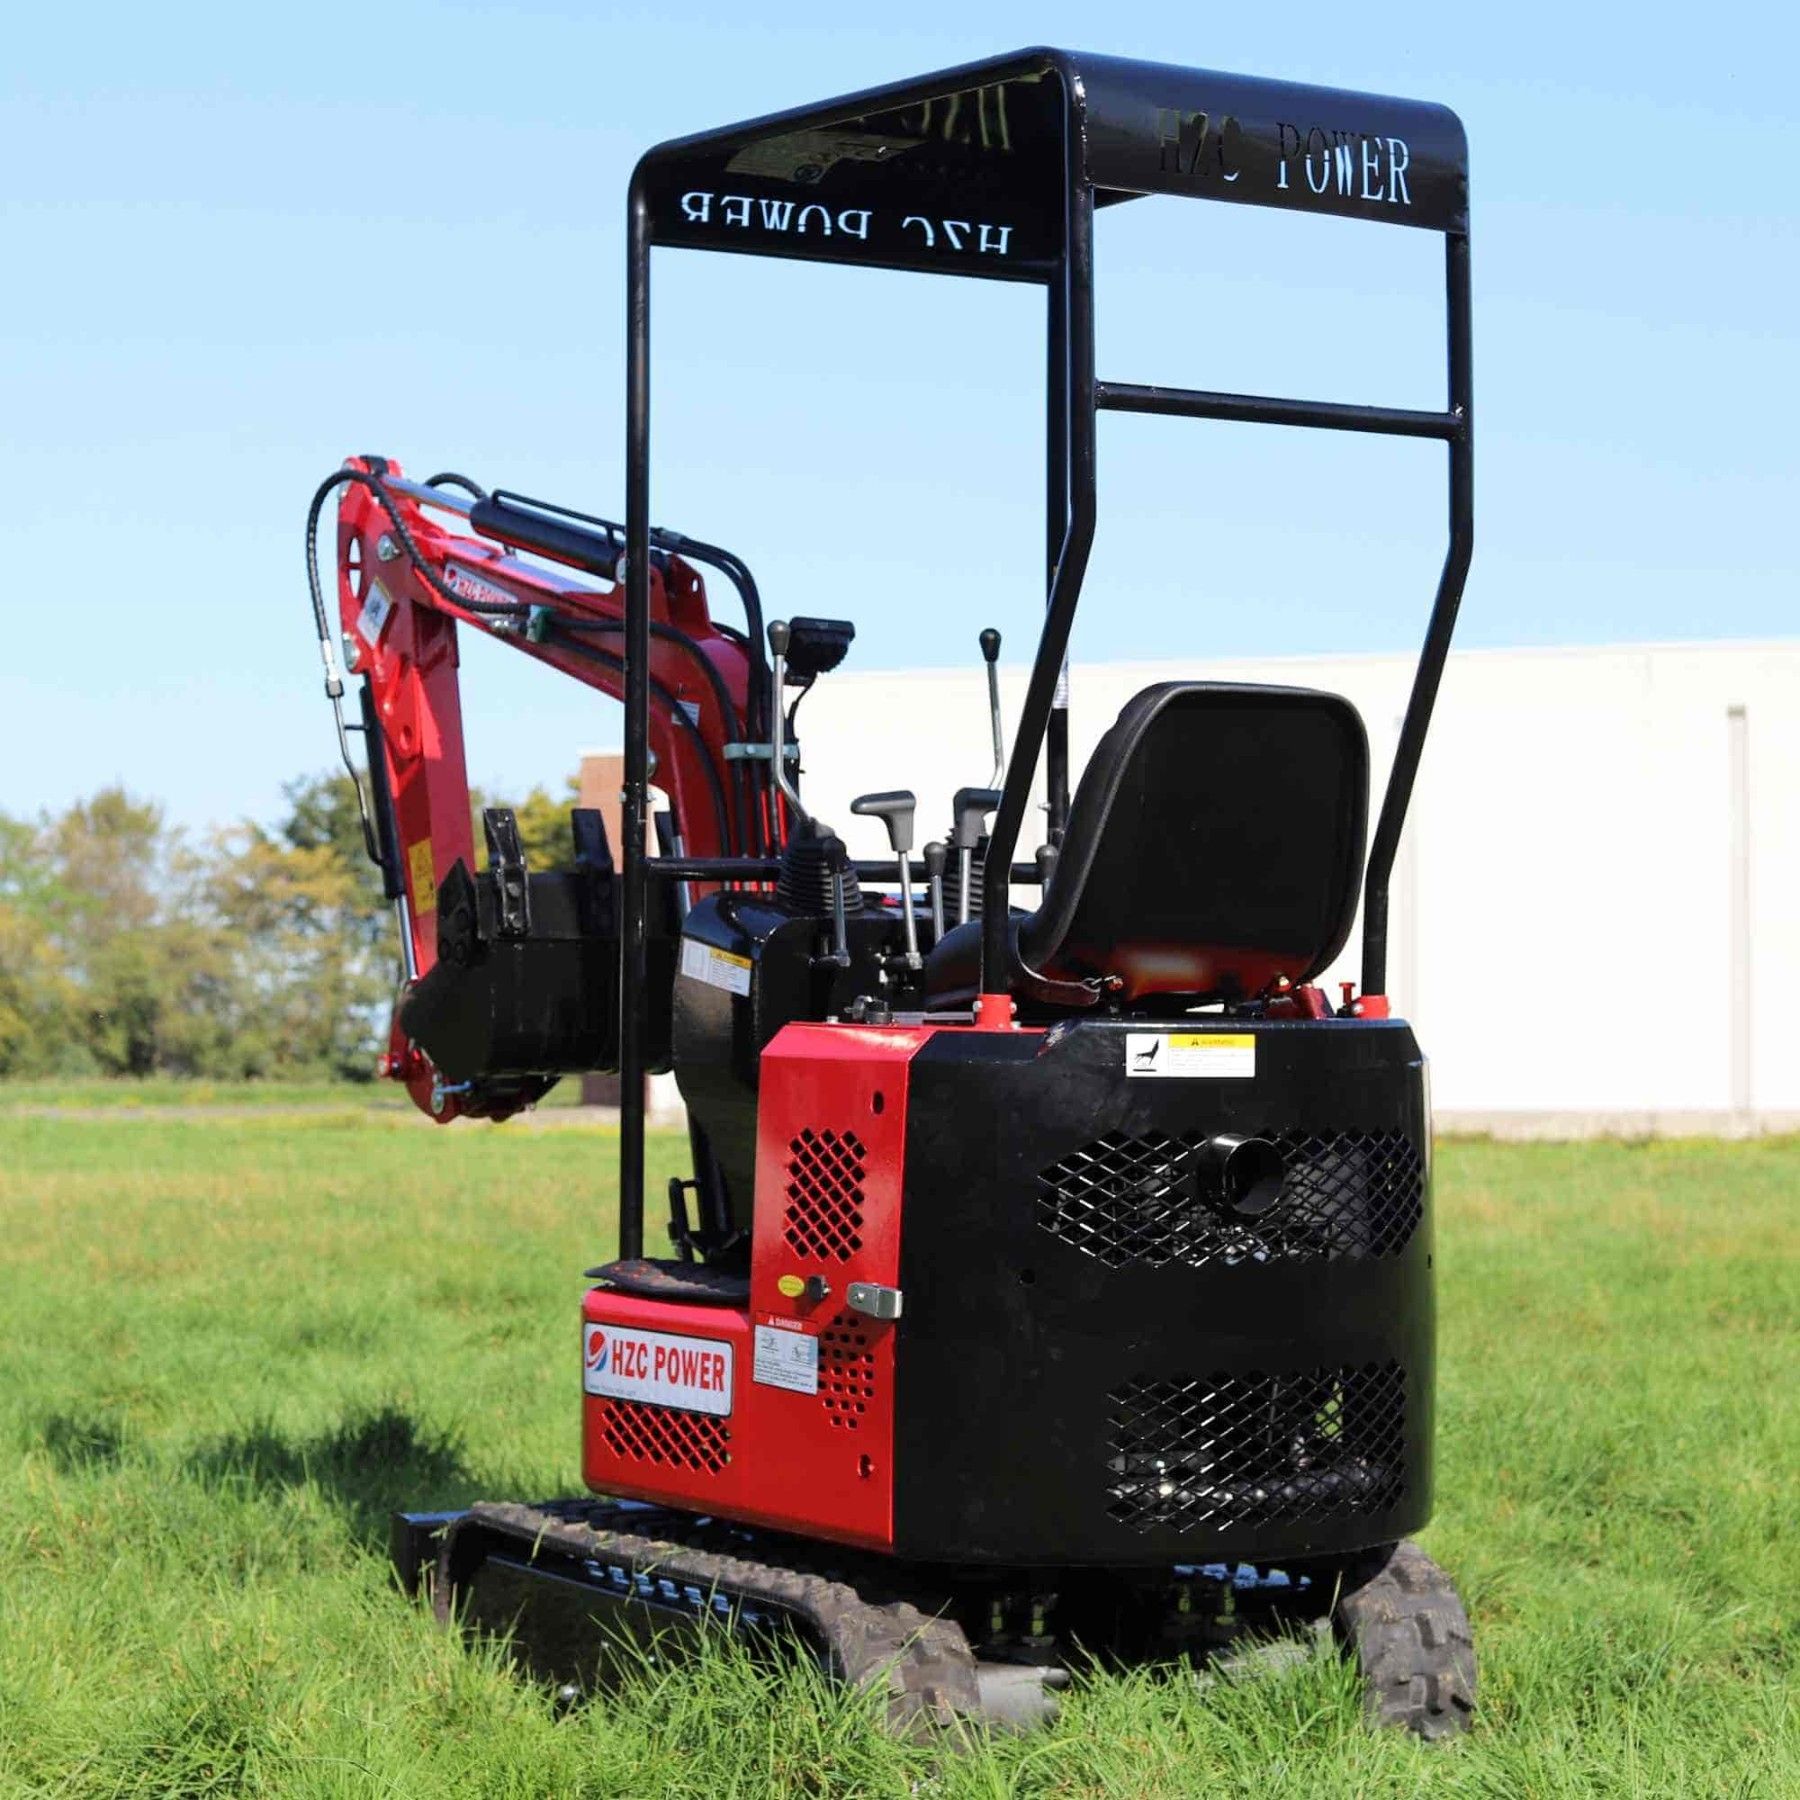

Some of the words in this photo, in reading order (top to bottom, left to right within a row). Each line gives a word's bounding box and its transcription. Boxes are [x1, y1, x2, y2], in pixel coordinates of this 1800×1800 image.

[1155, 107, 1240, 182] HZC
[1275, 121, 1411, 205] POWER
[611, 1338, 648, 1379] HZC
[654, 1345, 725, 1391] POWER
